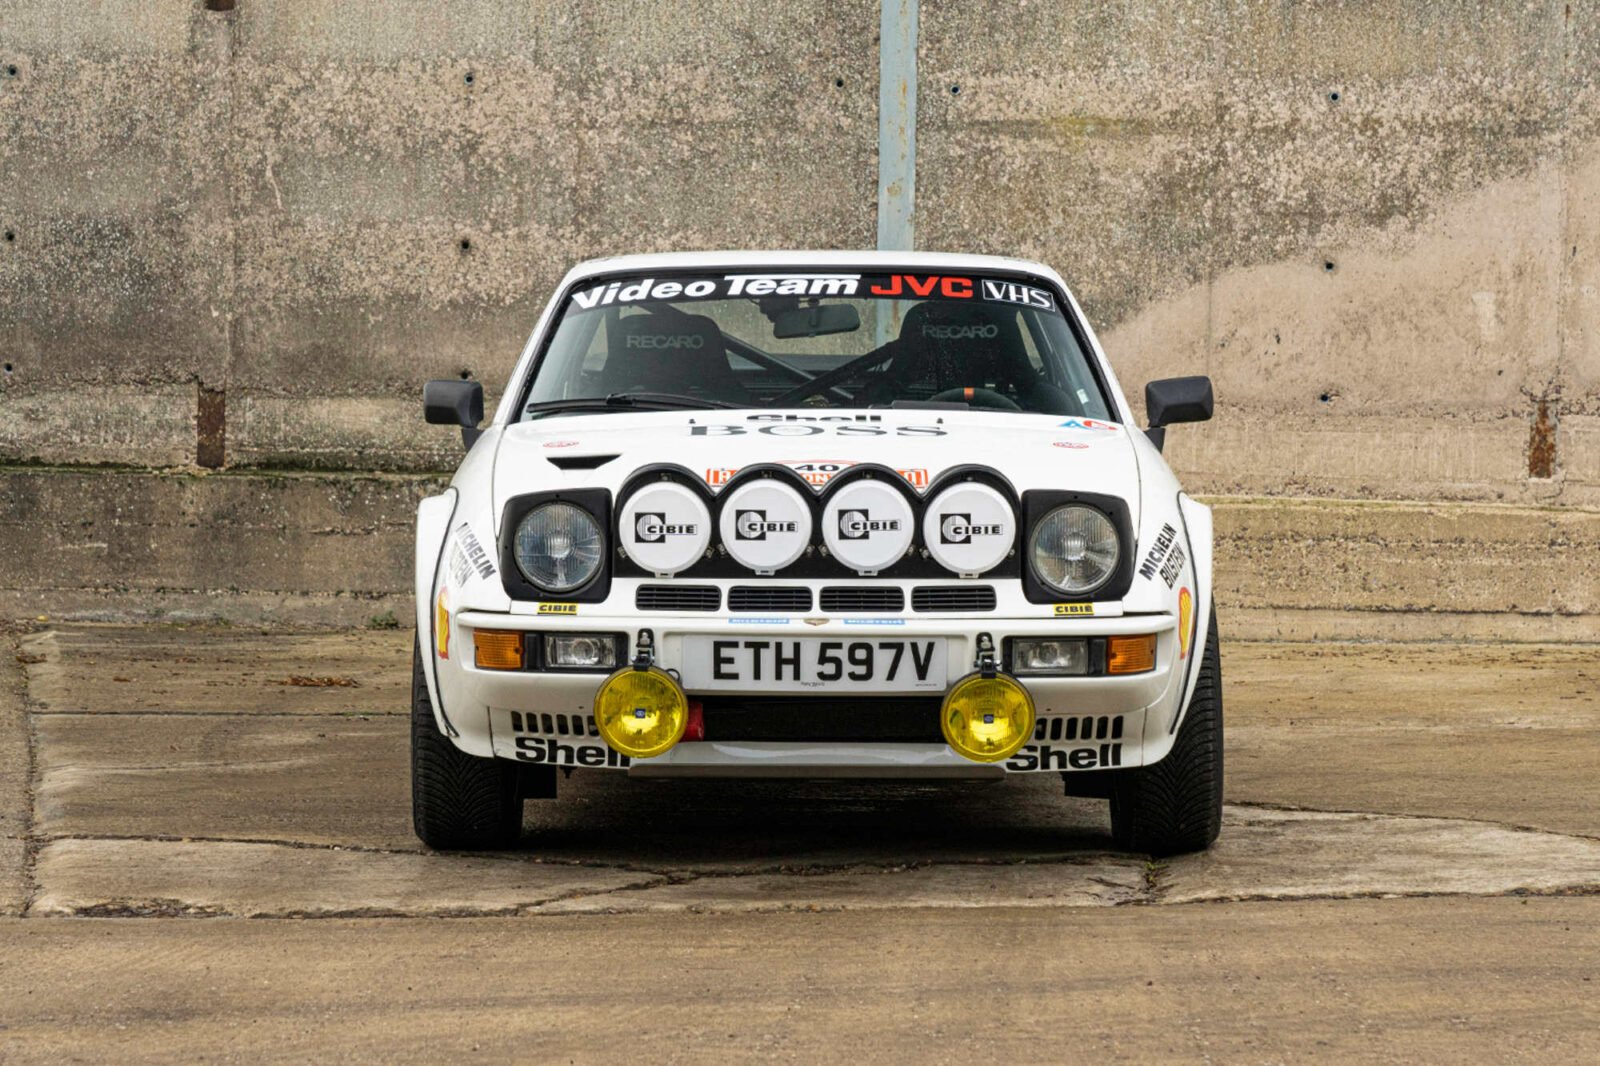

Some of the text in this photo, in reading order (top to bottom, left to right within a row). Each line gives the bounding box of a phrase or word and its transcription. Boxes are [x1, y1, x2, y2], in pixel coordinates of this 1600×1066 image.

[572, 274, 1051, 309] Video Team JVC VHS
[626, 335, 704, 349] RECARO
[923, 324, 998, 339] RECARO
[690, 425, 948, 436] BOSS
[795, 464, 839, 472] 40
[1139, 522, 1177, 581] MICHELIN
[713, 641, 936, 681] ETH 597V
[515, 736, 631, 767] Shell
[1006, 743, 1123, 771] Shell
